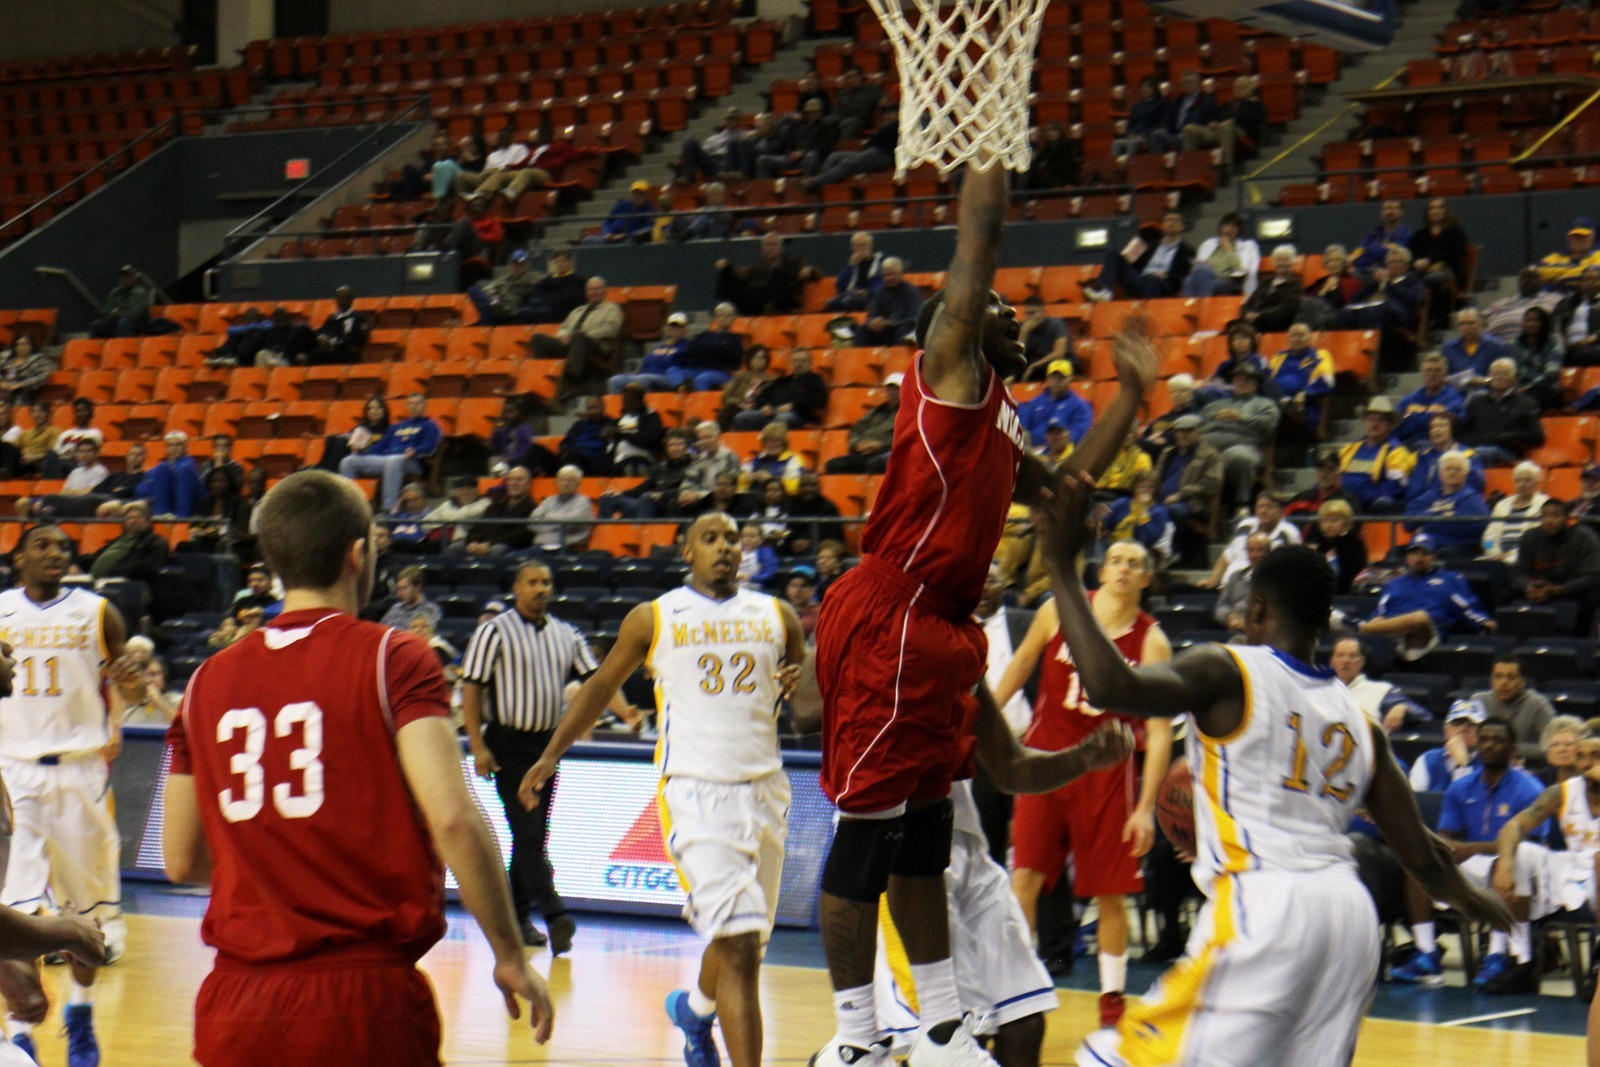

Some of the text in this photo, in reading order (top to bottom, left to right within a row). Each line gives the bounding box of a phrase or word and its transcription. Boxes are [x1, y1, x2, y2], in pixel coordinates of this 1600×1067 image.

[671, 618, 775, 648] McNEESE
[22, 655, 63, 696] 11
[697, 650, 757, 696] 32
[1062, 671, 1107, 718] 1
[216, 700, 325, 824] 33
[1281, 710, 1358, 804] 12
